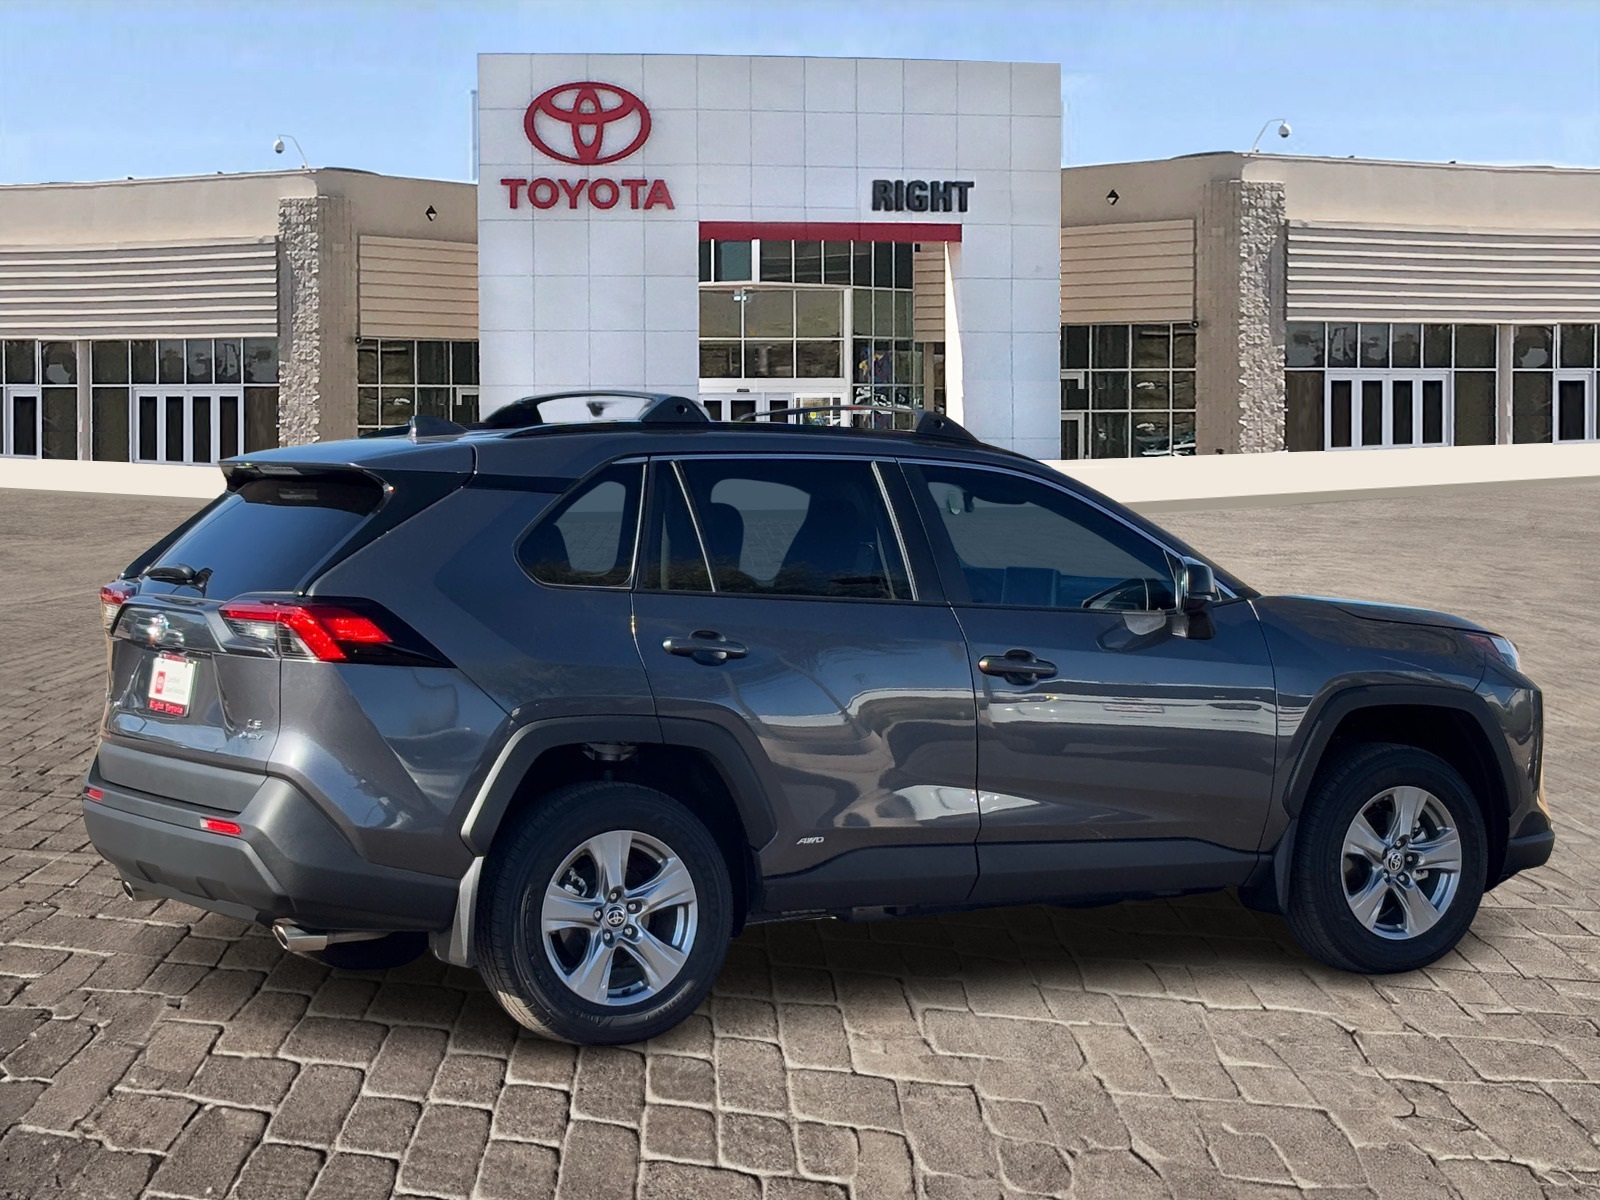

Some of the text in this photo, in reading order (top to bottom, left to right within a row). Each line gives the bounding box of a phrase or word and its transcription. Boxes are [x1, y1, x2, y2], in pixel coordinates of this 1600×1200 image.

[500, 177, 675, 210] TOYOTA
[872, 179, 974, 212] RIGHT
[796, 836, 825, 844] AWD
